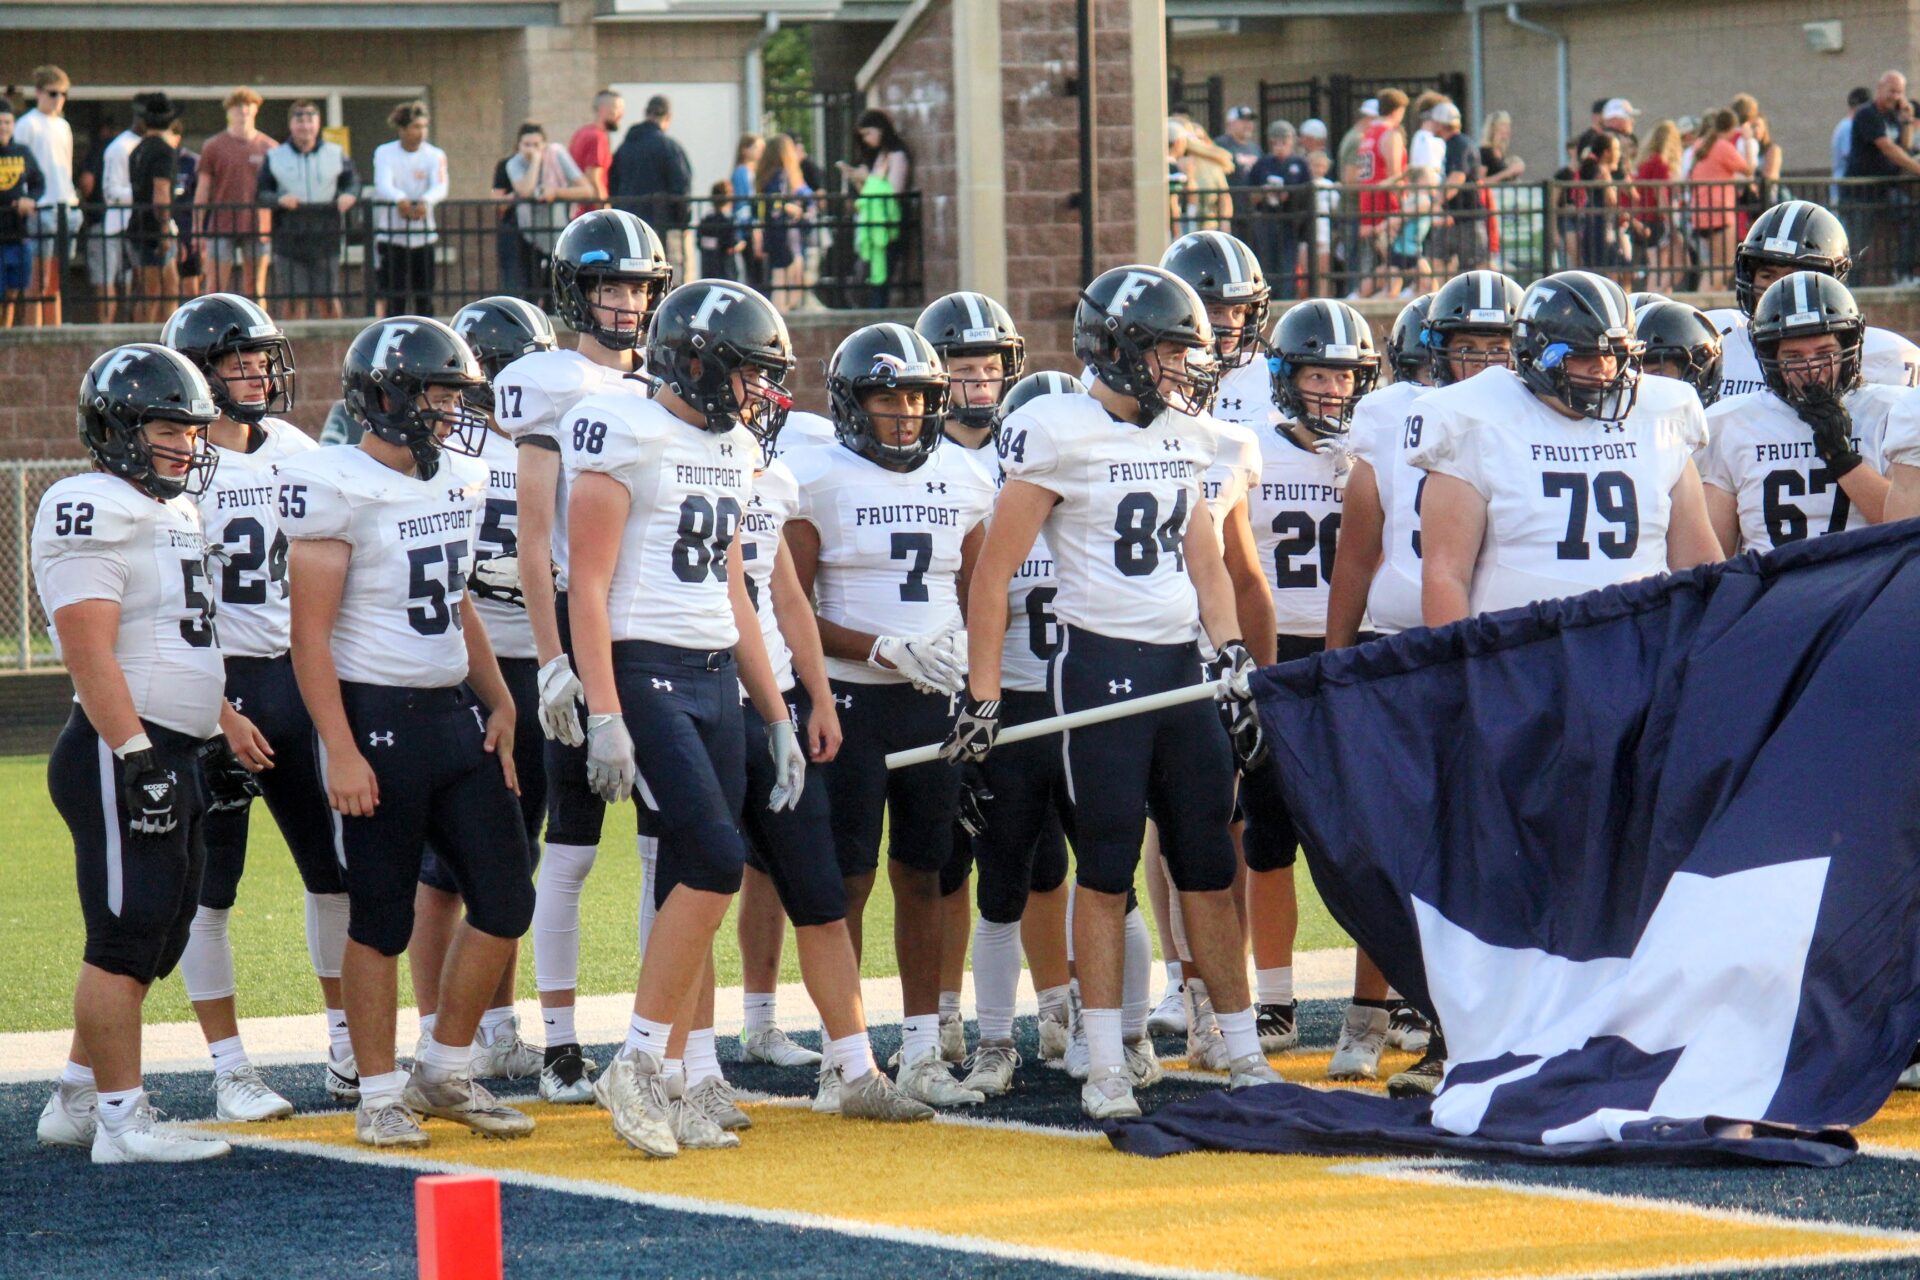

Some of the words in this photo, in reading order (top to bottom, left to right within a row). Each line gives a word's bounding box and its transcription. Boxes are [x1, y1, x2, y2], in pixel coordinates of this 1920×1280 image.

[689, 286, 745, 331] F
[1105, 271, 1163, 317] F
[1516, 286, 1557, 338] F
[167, 301, 205, 350] F
[371, 323, 420, 370] F
[96, 348, 151, 392] F
[500, 385, 523, 419] 17
[572, 417, 608, 455] 88
[1000, 426, 1028, 464] 84
[1530, 441, 1638, 463] FRUITPORT
[1756, 437, 1862, 462] FRUITT
[676, 464, 742, 488] FRUITPORT
[1109, 460, 1194, 483] FRUITPORT
[278, 484, 308, 519] 55
[1261, 483, 1344, 503] FRUITPO
[1763, 469, 1851, 547] 67
[55, 502, 95, 537] 52
[397, 509, 473, 540] FRUITPORT
[855, 504, 960, 527] FRUITPORT
[1114, 488, 1188, 577] 84
[1542, 470, 1640, 560] 79
[671, 494, 743, 583] 88
[407, 539, 469, 636] 55
[890, 532, 933, 602] 7
